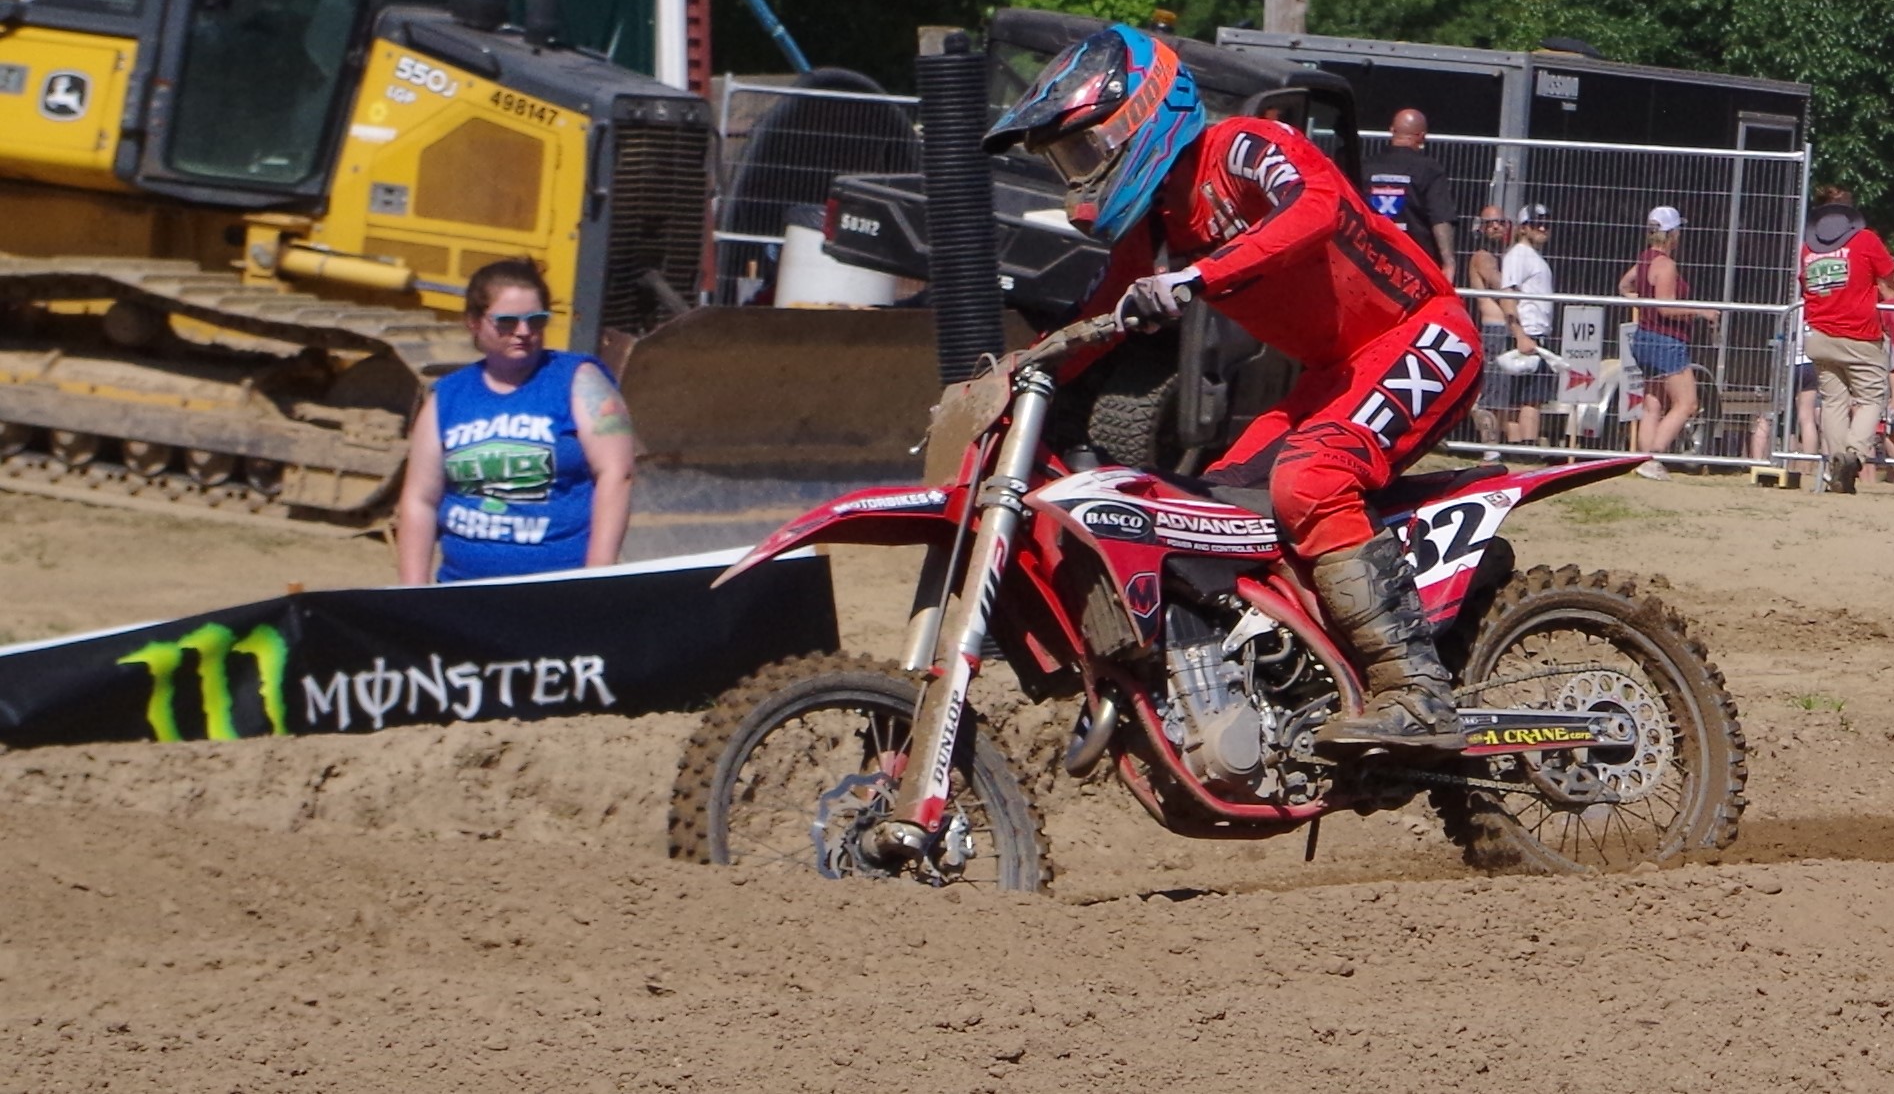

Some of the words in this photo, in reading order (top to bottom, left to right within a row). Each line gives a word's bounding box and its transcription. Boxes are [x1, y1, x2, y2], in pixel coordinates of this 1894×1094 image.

[489, 89, 559, 127] 498147
[1571, 322, 1596, 342] VIP
[445, 413, 556, 449] TRACK
[446, 505, 550, 545] CREW
[1084, 512, 1144, 529] BASCO
[301, 652, 617, 732] MONSTER
[933, 689, 961, 789] DUNLOP
[1503, 727, 1570, 745] CRANE
